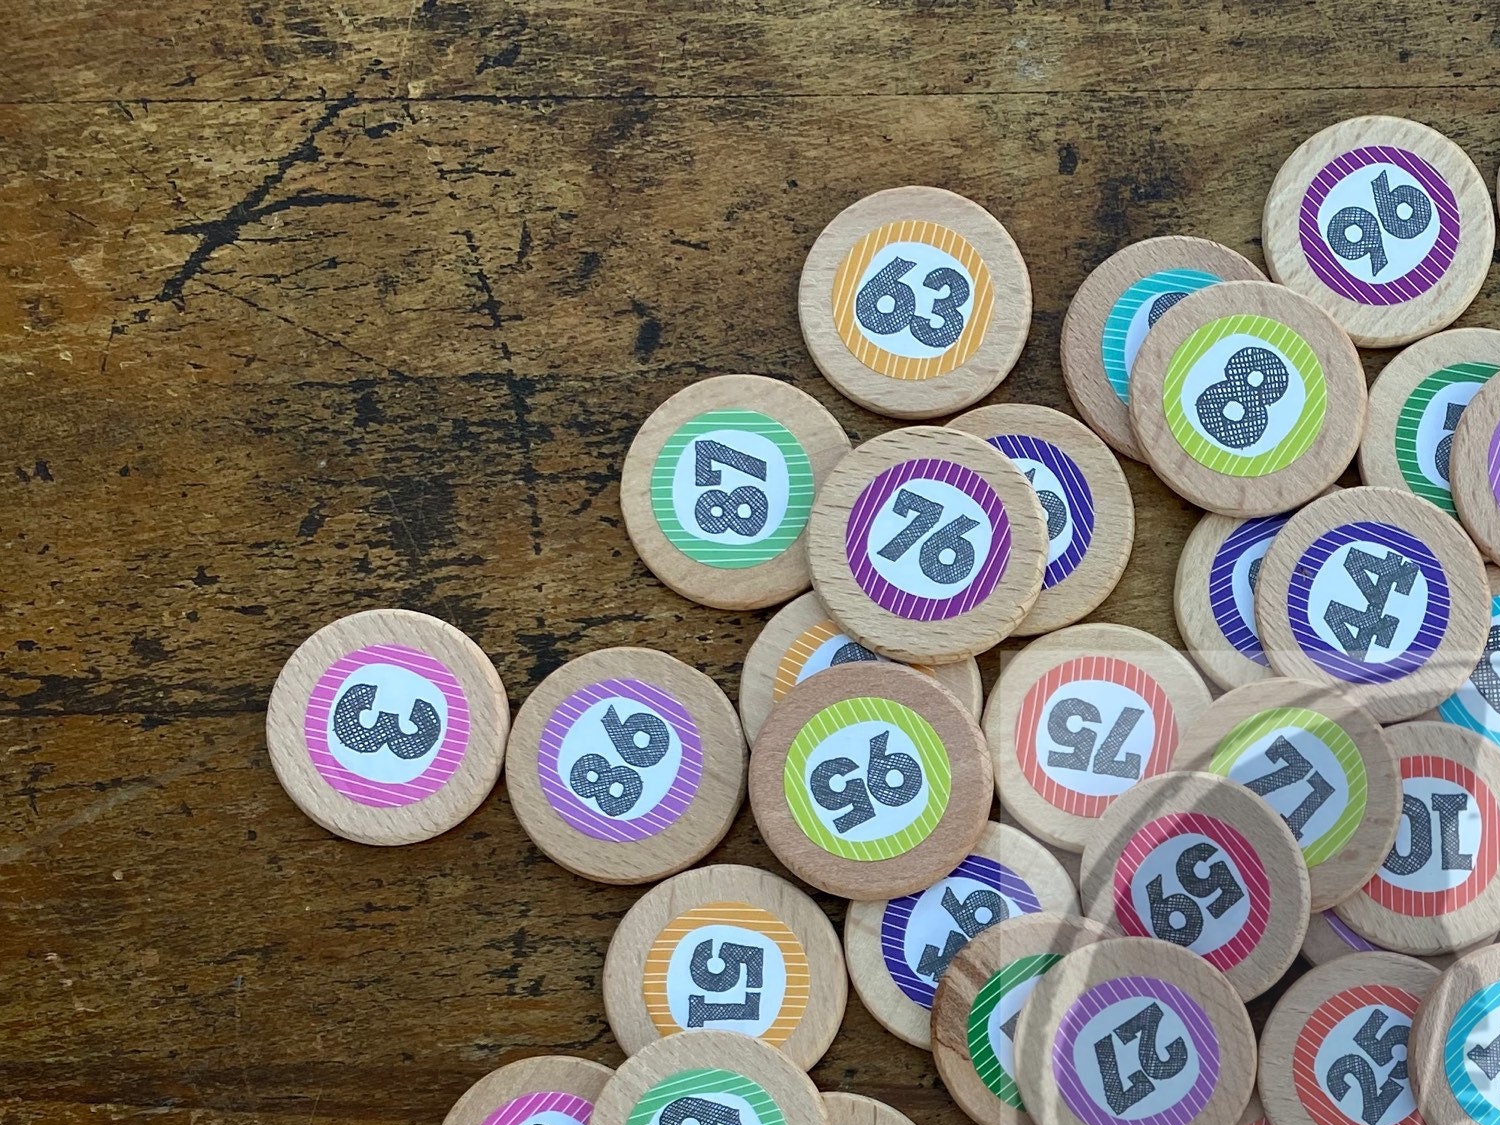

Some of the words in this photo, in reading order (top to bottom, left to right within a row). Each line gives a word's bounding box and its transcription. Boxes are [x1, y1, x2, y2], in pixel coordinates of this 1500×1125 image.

[1326, 170, 1434, 278] 96
[854, 256, 974, 349] 63
[1196, 347, 1290, 450] 8
[695, 441, 770, 538] 87
[879, 491, 979, 586] 76
[1324, 546, 1421, 662] 44
[334, 684, 443, 761] 3
[1049, 700, 1145, 781] 75
[811, 733, 924, 835] 95
[1245, 737, 1337, 843] 71
[1383, 793, 1473, 878] 10
[1146, 842, 1246, 947] 59
[687, 940, 765, 1029] 51
[1092, 1000, 1190, 1117] 27
